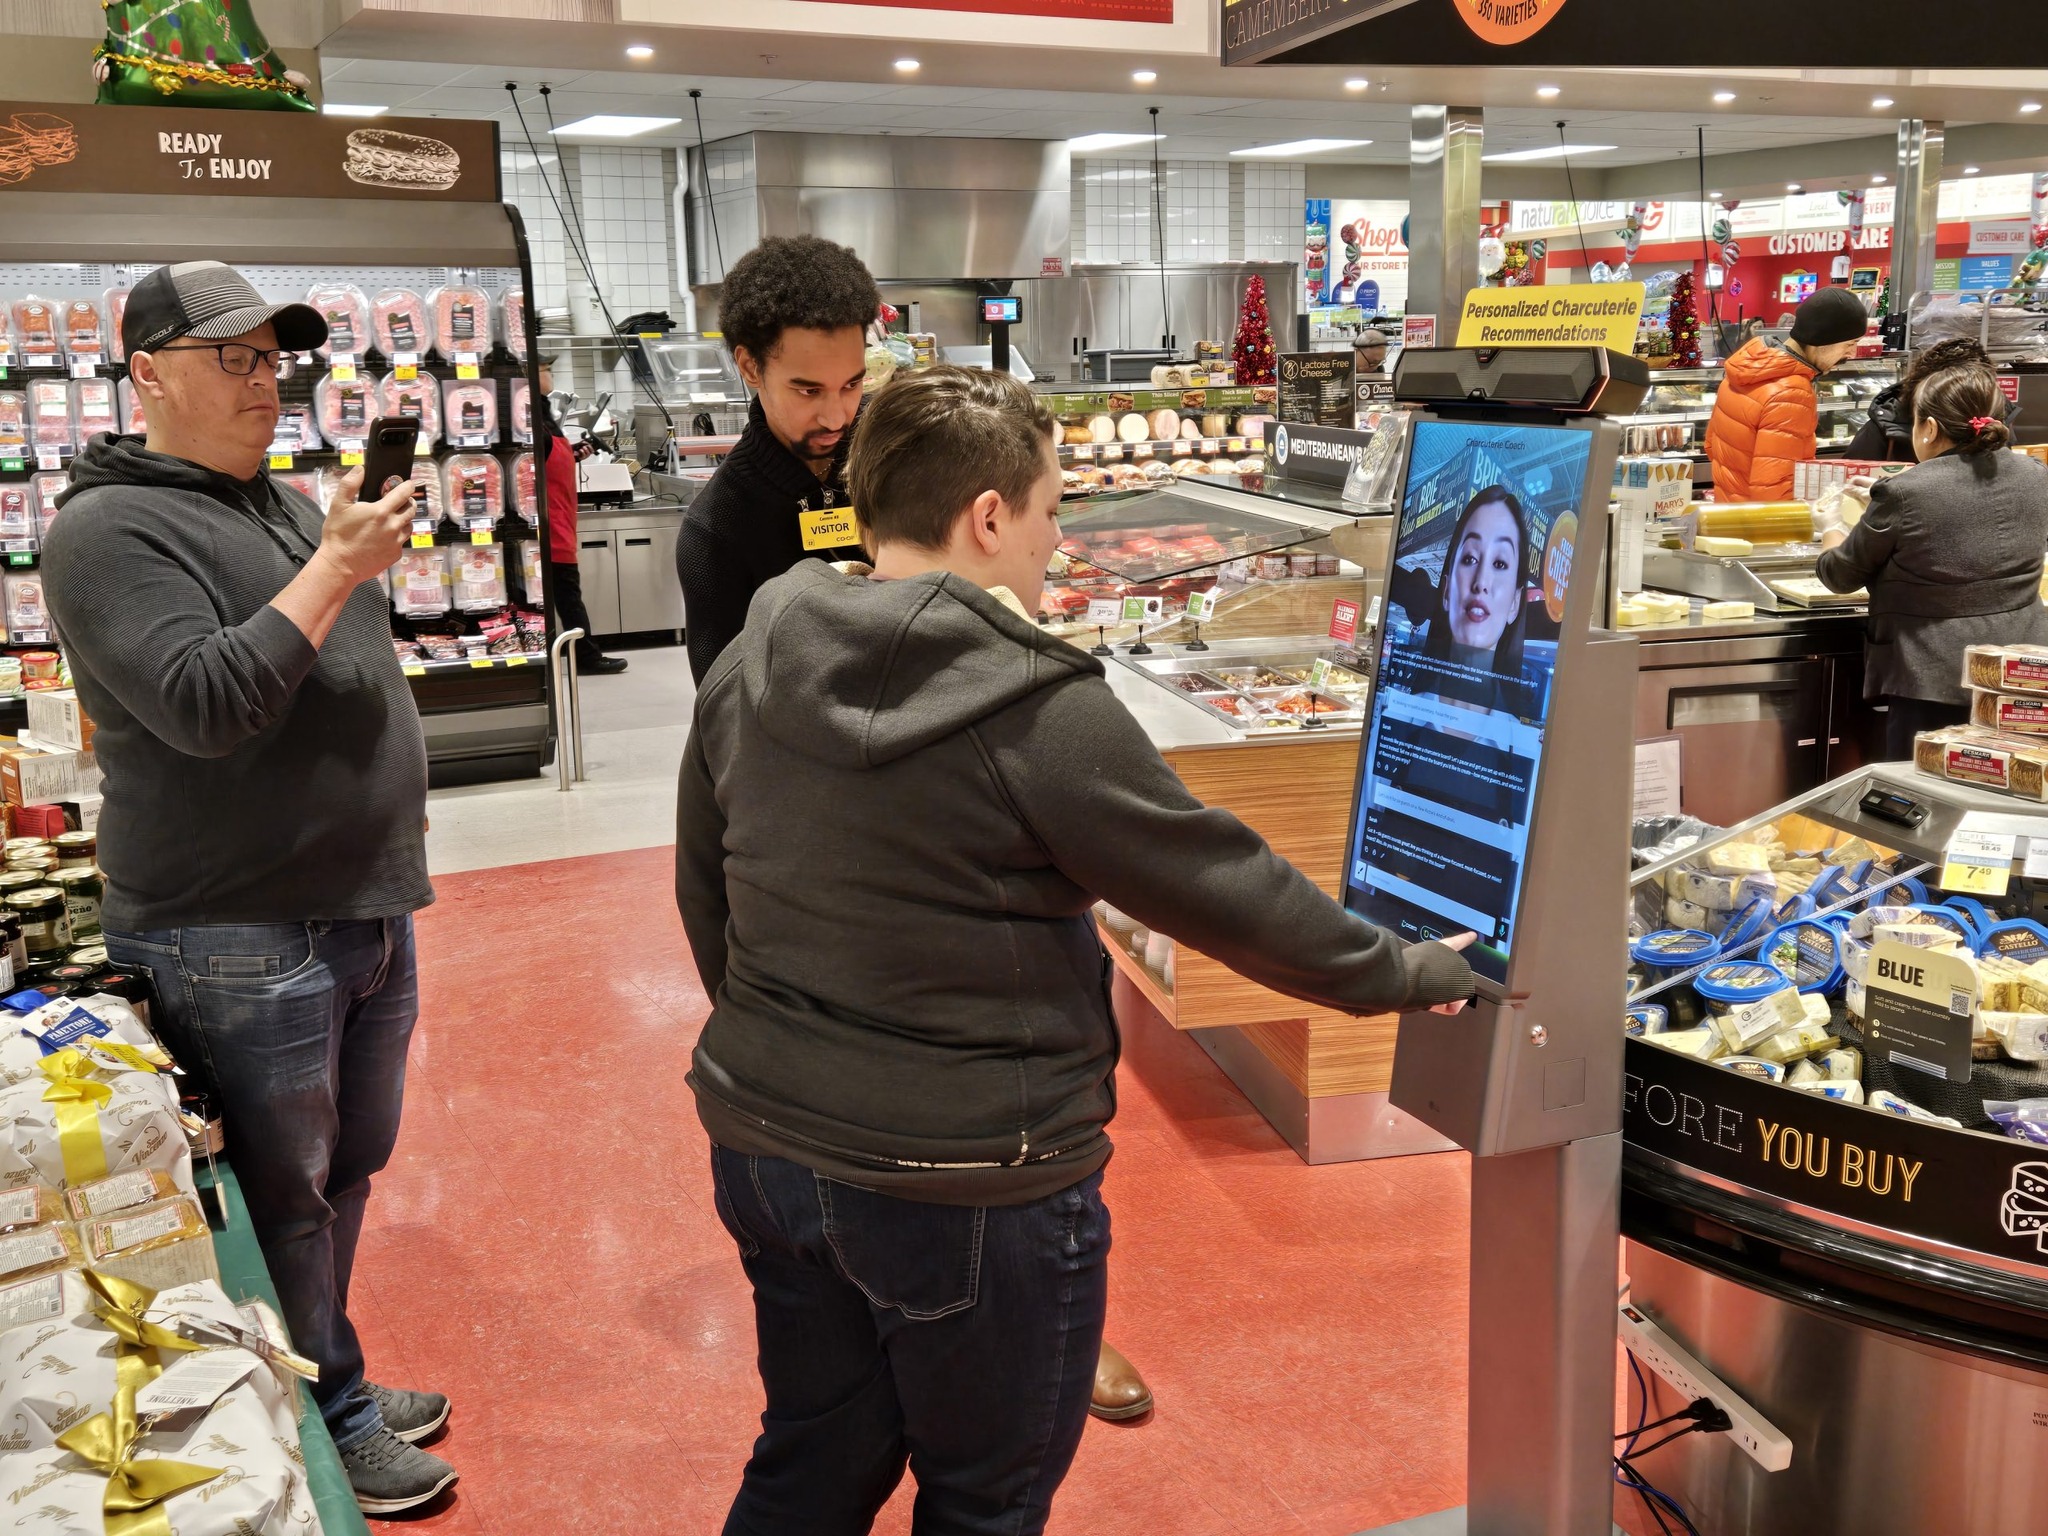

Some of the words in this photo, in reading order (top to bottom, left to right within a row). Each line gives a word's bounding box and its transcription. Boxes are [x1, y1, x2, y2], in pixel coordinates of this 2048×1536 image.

[1478, 0, 1493, 20] 350
[1495, 0, 1538, 26] VARIETIES
[158, 132, 222, 154] READY
[178, 159, 204, 179] To
[210, 158, 272, 180] ENJOY
[1353, 218, 1398, 255] Shop
[1769, 230, 1846, 255] CUSTOMER
[1976, 232, 2008, 242] CUSTOMER
[2010, 232, 2025, 242] CARE
[1371, 262, 1400, 270] STORE
[1466, 300, 1548, 319] Personalized
[1552, 298, 1638, 317] Charcuterie
[1481, 324, 1608, 343] Recommendations
[1300, 360, 1331, 370] Lactose
[1332, 359, 1350, 369] Free
[1300, 368, 1333, 378] Cheeses
[1290, 438, 1355, 462] MEDITERRANEAN
[1466, 438, 1503, 449] Charcuterie
[1504, 440, 1526, 450] Coach
[1473, 449, 1501, 489] BRIE
[1419, 473, 1440, 513] BRIE
[1655, 498, 1684, 511] MARY'S
[811, 522, 849, 535] VISITOR
[1548, 546, 1571, 588] CHEE
[1336, 611, 1355, 623] ALERT
[1853, 888, 1872, 900] LIMIT
[1798, 934, 1832, 954] CASTELLO
[1998, 940, 2039, 951] CASTELLO
[1708, 954, 1728, 965] LIMIT
[1878, 958, 1925, 988] BLUE
[1874, 994, 1885, 1002] Soft
[47, 1016, 93, 1041] PANETTONE
[1623, 1072, 1743, 1154] FORE
[1757, 1118, 1830, 1178] YOU
[1841, 1143, 1924, 1202] BUY
[131, 1132, 168, 1166] Vincenzo
